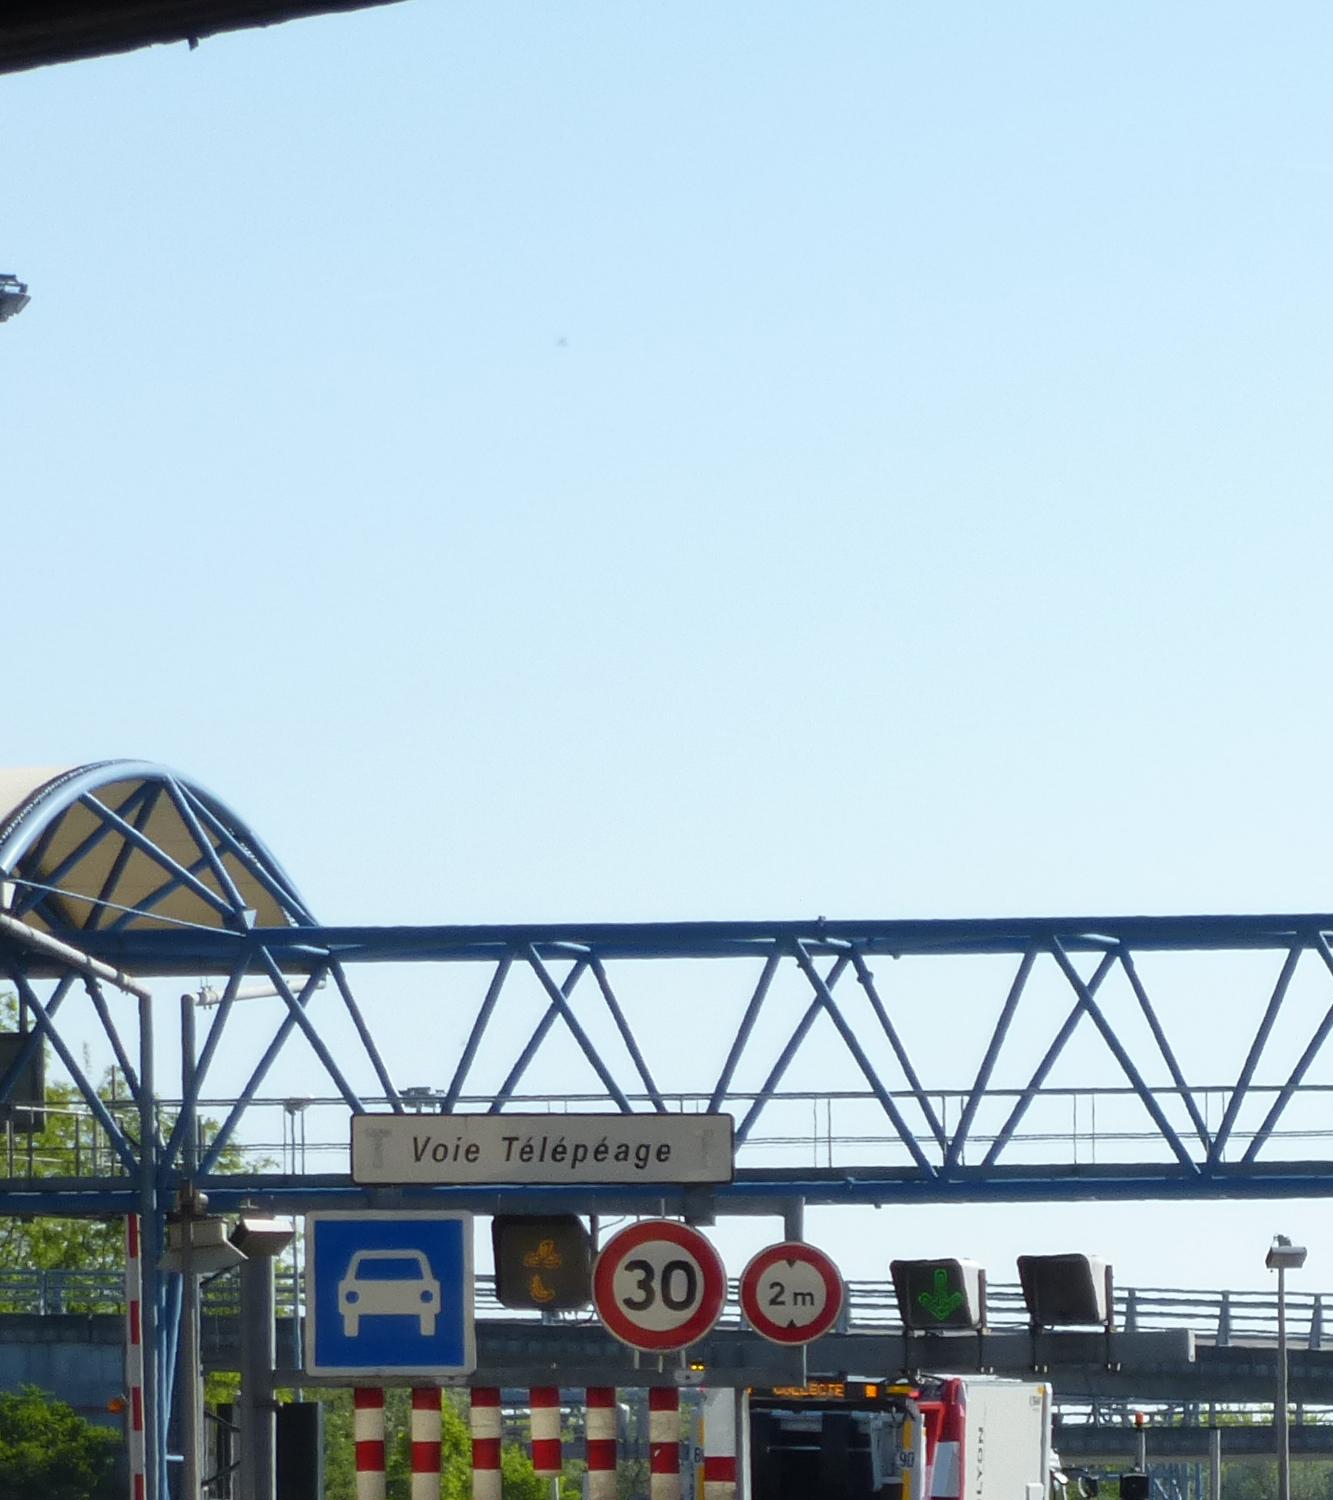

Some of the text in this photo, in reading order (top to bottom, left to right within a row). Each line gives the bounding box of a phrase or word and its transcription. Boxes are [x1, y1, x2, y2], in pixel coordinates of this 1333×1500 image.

[412, 1136, 481, 1163] Voie
[502, 1136, 673, 1169] Télépéage
[622, 1259, 698, 1312] 30
